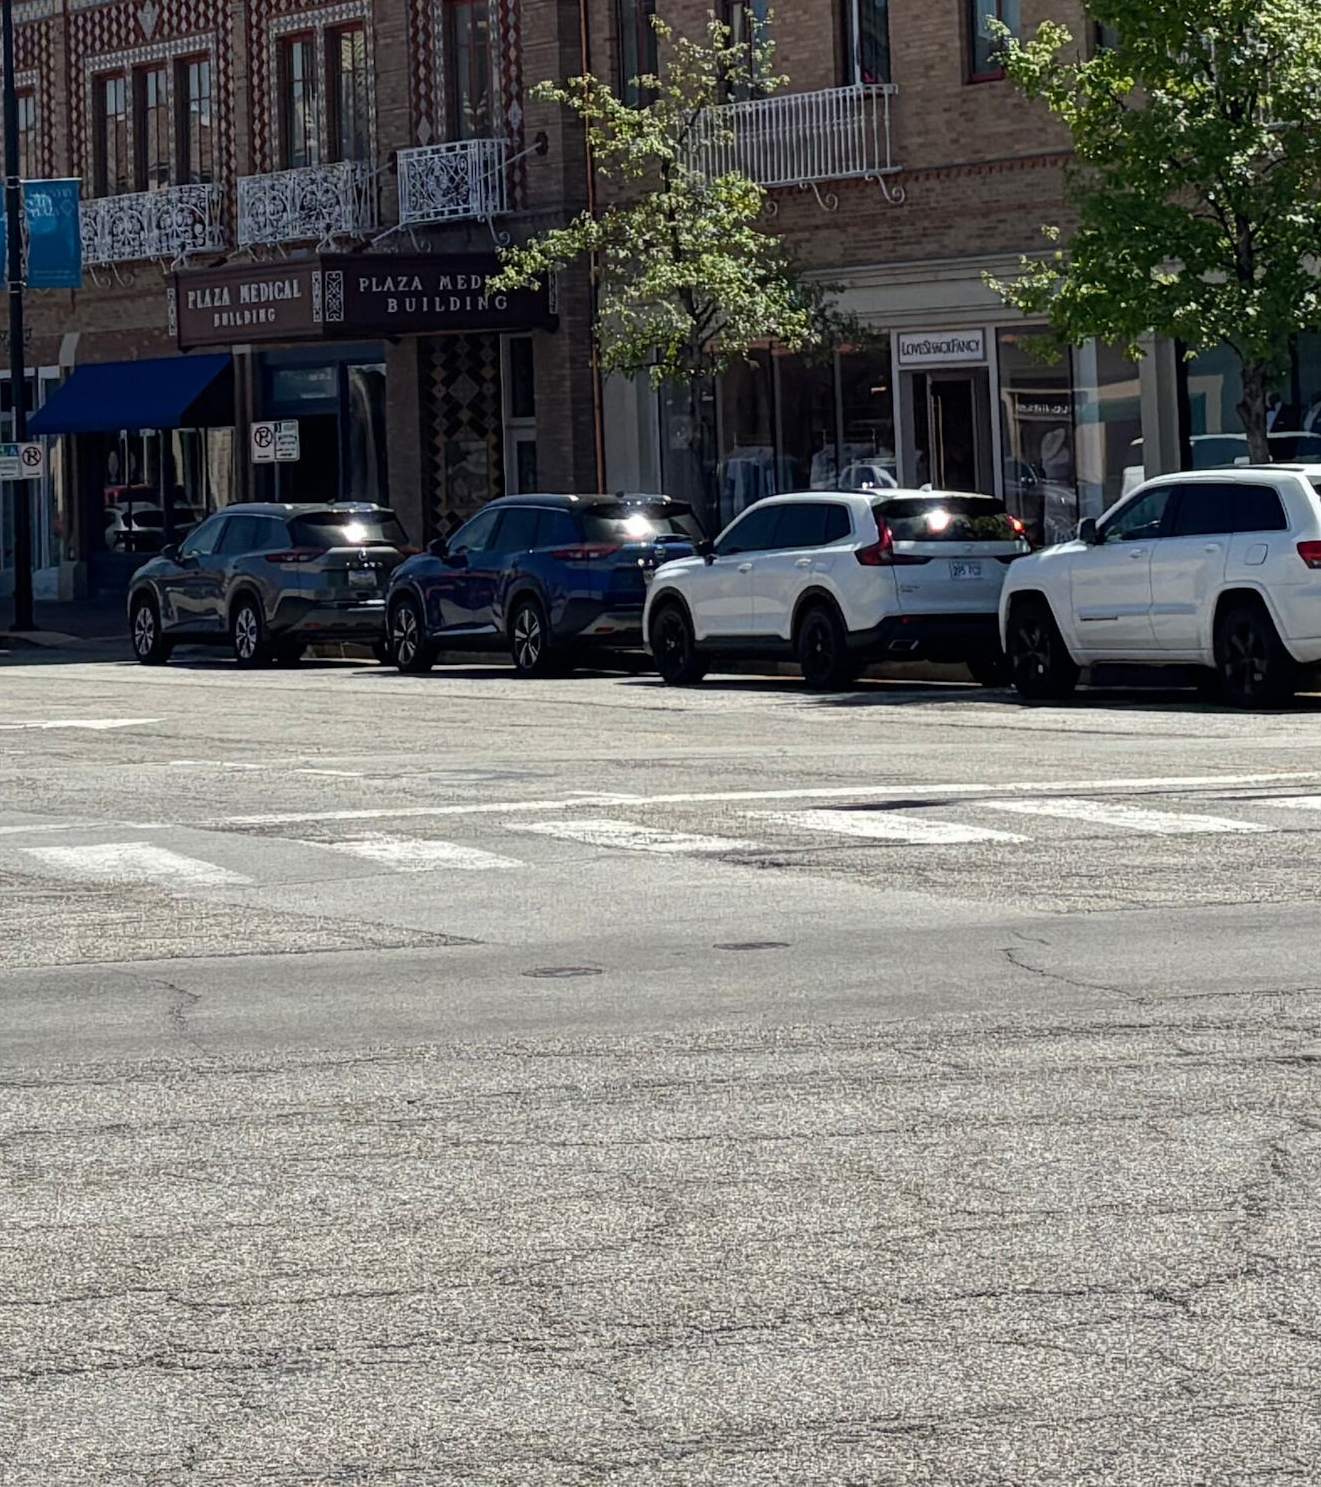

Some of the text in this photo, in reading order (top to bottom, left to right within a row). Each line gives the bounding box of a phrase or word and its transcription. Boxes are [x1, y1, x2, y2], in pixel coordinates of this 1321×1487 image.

[359, 276, 423, 292] PLAZA
[187, 279, 302, 309] PLAZA MEDICAL
[387, 296, 507, 313] BUILDING
[213, 309, 275, 327] BUILDING
